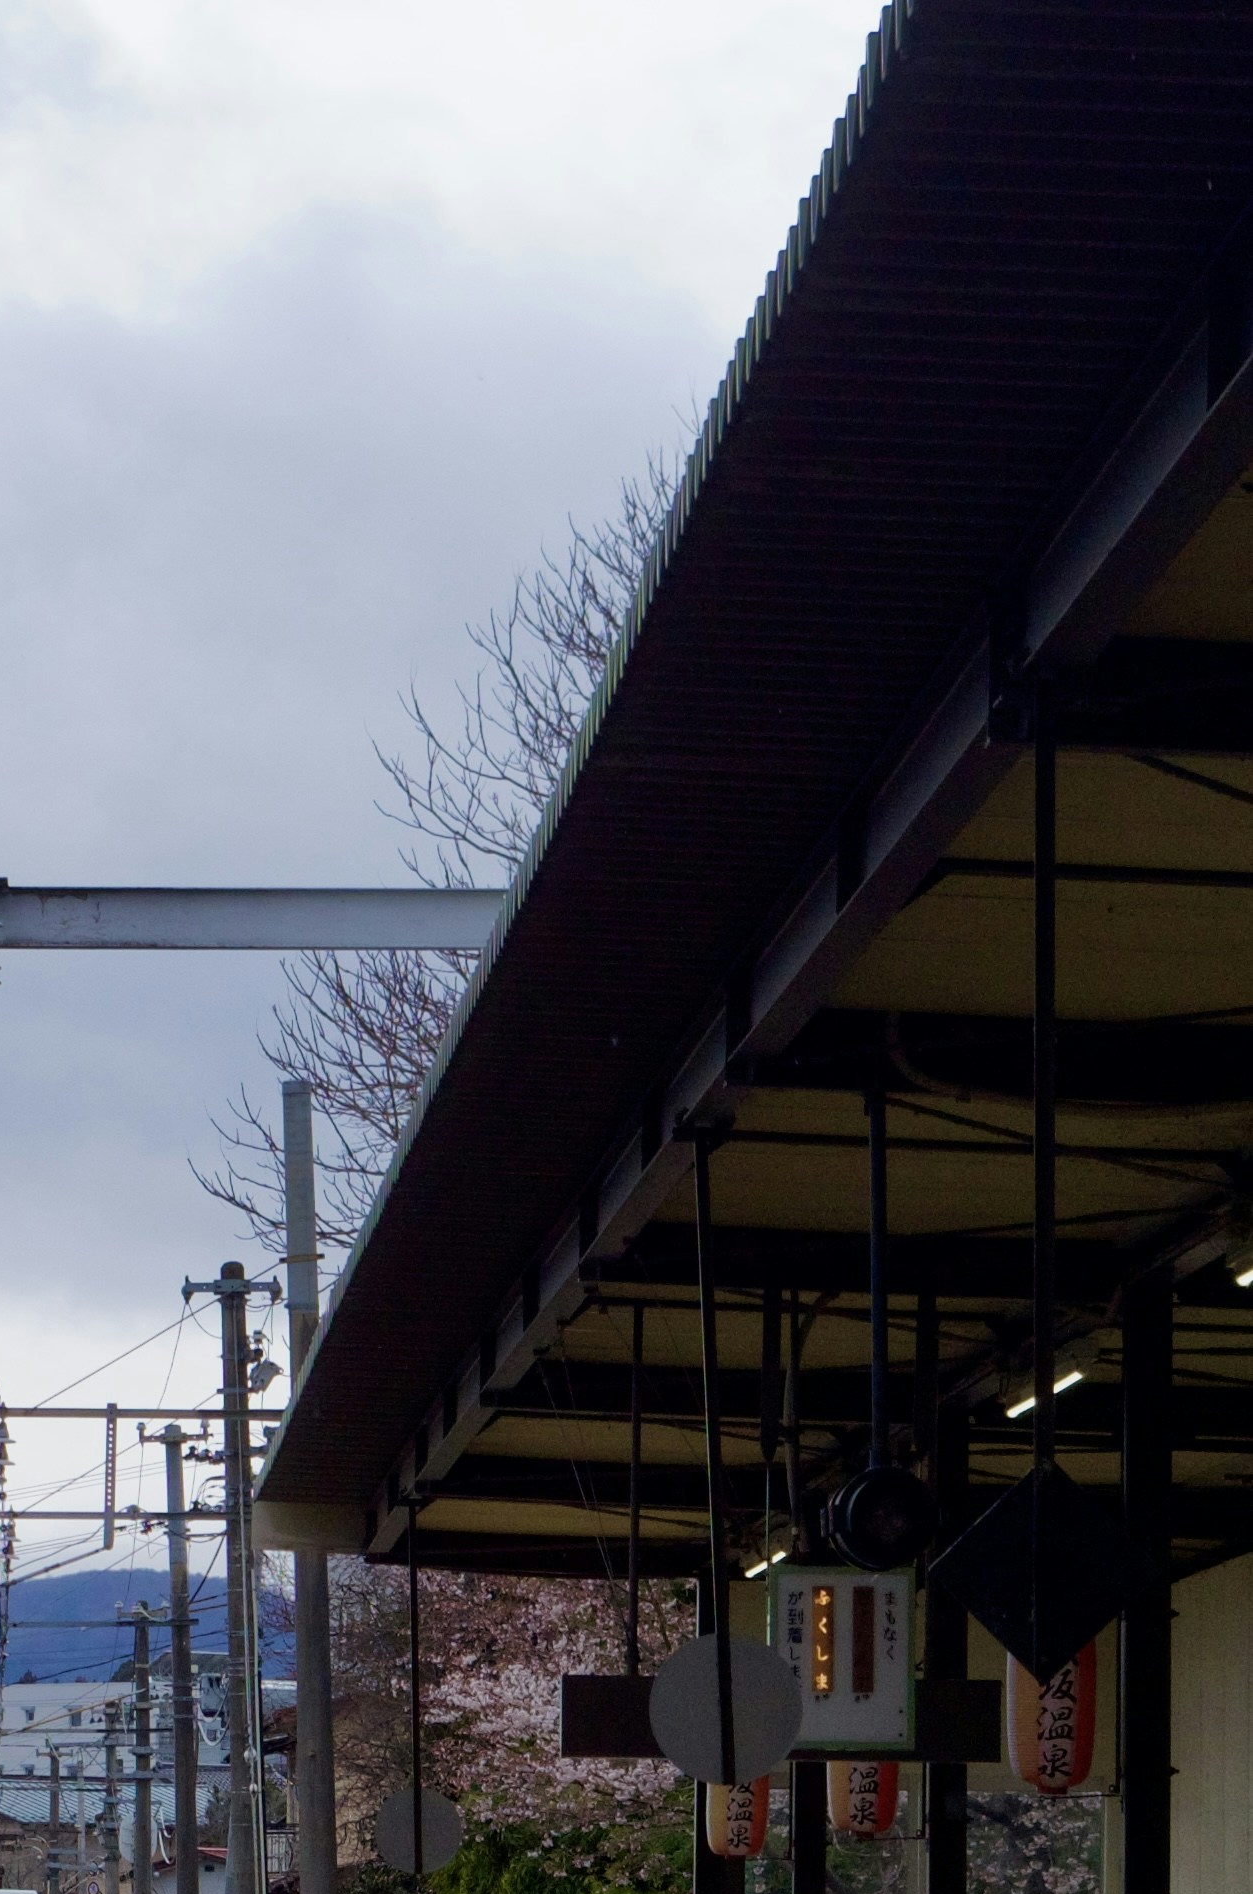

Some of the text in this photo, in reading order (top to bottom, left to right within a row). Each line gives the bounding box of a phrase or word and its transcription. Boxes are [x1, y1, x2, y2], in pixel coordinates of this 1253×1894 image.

[787, 1591, 804, 1688] が到着しま
[814, 1589, 831, 1690] ふくしま
[883, 1590, 897, 1661] まもなく
[1036, 1655, 1078, 1777] 坂温泉
